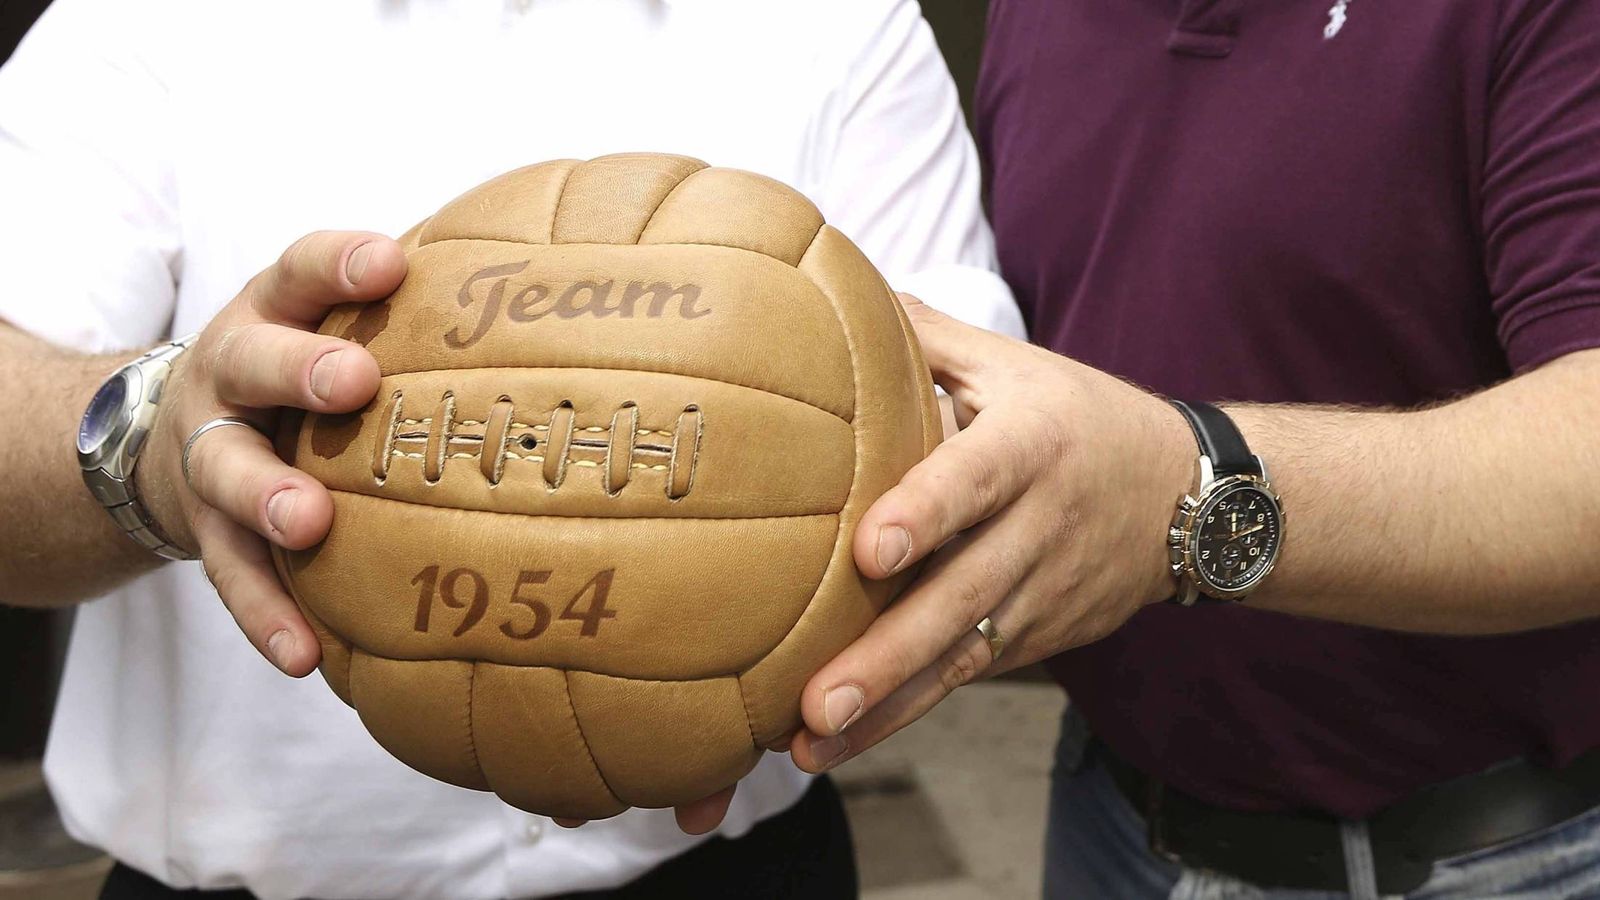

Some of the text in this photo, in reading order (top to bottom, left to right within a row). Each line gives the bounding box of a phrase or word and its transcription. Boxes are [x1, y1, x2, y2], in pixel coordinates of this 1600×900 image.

[443, 260, 711, 350] Team
[1219, 501, 1227, 510] 5
[1248, 500, 1256, 510] 7
[1207, 515, 1215, 524] 4
[1257, 513, 1265, 522] 8
[1201, 550, 1210, 559] 2
[1249, 547, 1260, 556] 10
[410, 564, 617, 640] 1954
